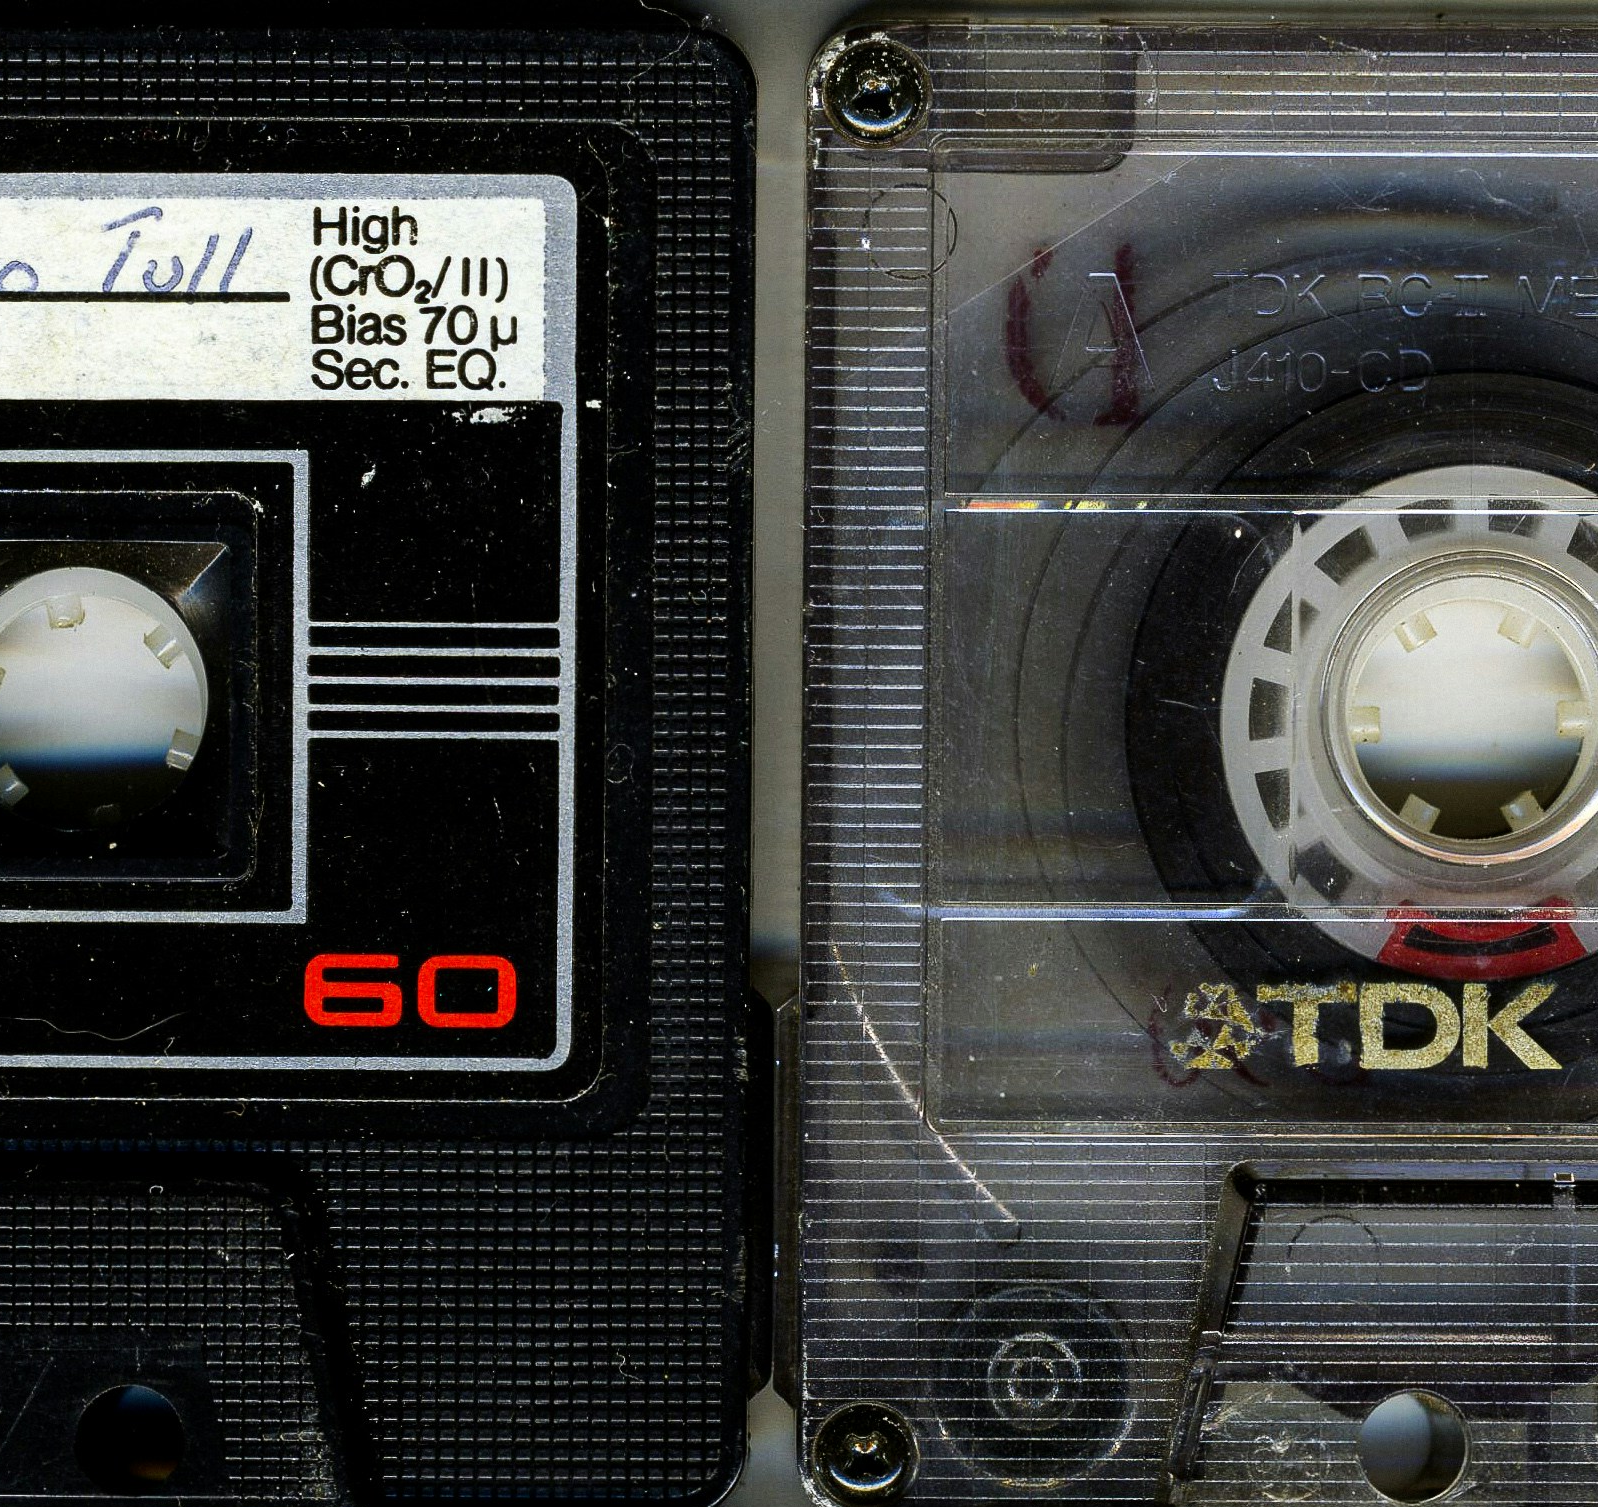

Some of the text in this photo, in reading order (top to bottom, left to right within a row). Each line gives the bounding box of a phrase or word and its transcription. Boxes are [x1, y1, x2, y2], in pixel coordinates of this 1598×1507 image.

[102, 207, 253, 296] Tull
[313, 207, 417, 253] High
[312, 306, 406, 345] Bias
[417, 306, 474, 346] 70
[311, 350, 507, 393] Sec. EQ.
[304, 953, 517, 1028] 60
[1257, 980, 1563, 1070] TDK
